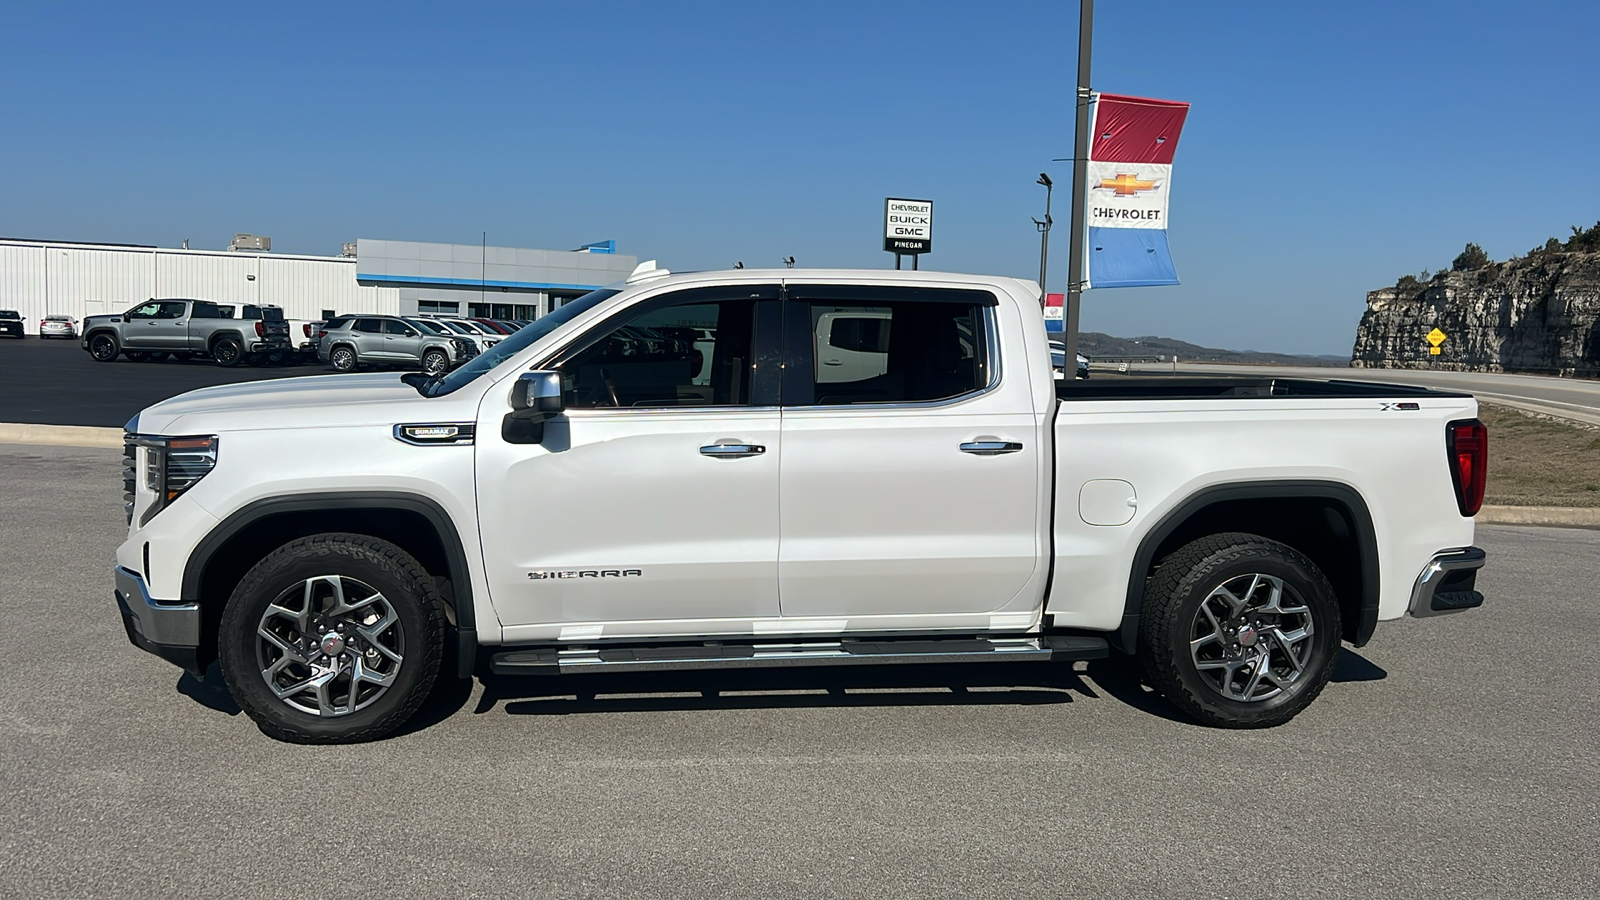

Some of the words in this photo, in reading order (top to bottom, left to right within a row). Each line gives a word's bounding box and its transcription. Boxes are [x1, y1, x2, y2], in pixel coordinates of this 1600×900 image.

[891, 204, 928, 213] CHEVROLET
[890, 215, 928, 225] BUICK
[895, 227, 923, 236] GMC
[894, 241, 923, 249] PINEGAR
[527, 569, 642, 580] SIERRA
